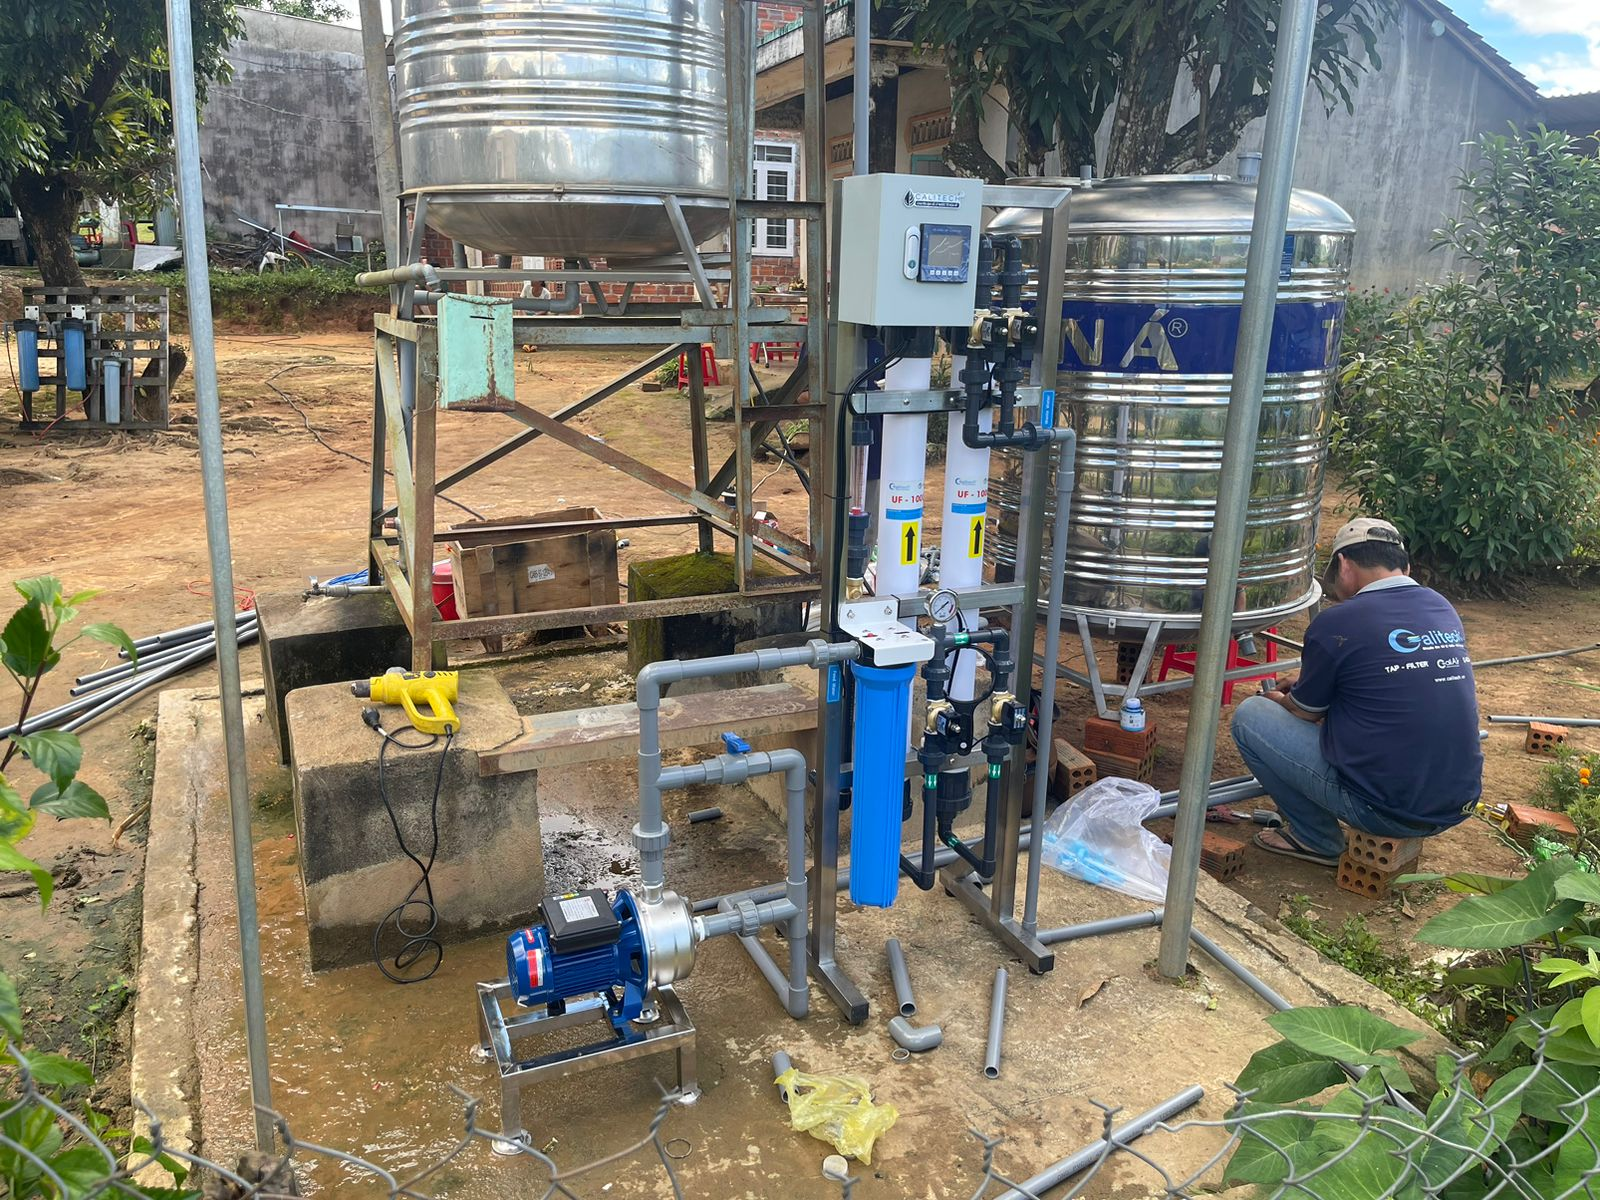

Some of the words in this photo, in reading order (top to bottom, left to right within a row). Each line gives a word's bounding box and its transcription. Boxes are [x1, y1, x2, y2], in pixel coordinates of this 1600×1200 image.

[915, 192, 960, 202] CALITECH
[957, 490, 969, 498] UF
[891, 495, 903, 504] UF
[1384, 665, 1400, 674] TAP
[1406, 660, 1429, 670] FILTER
